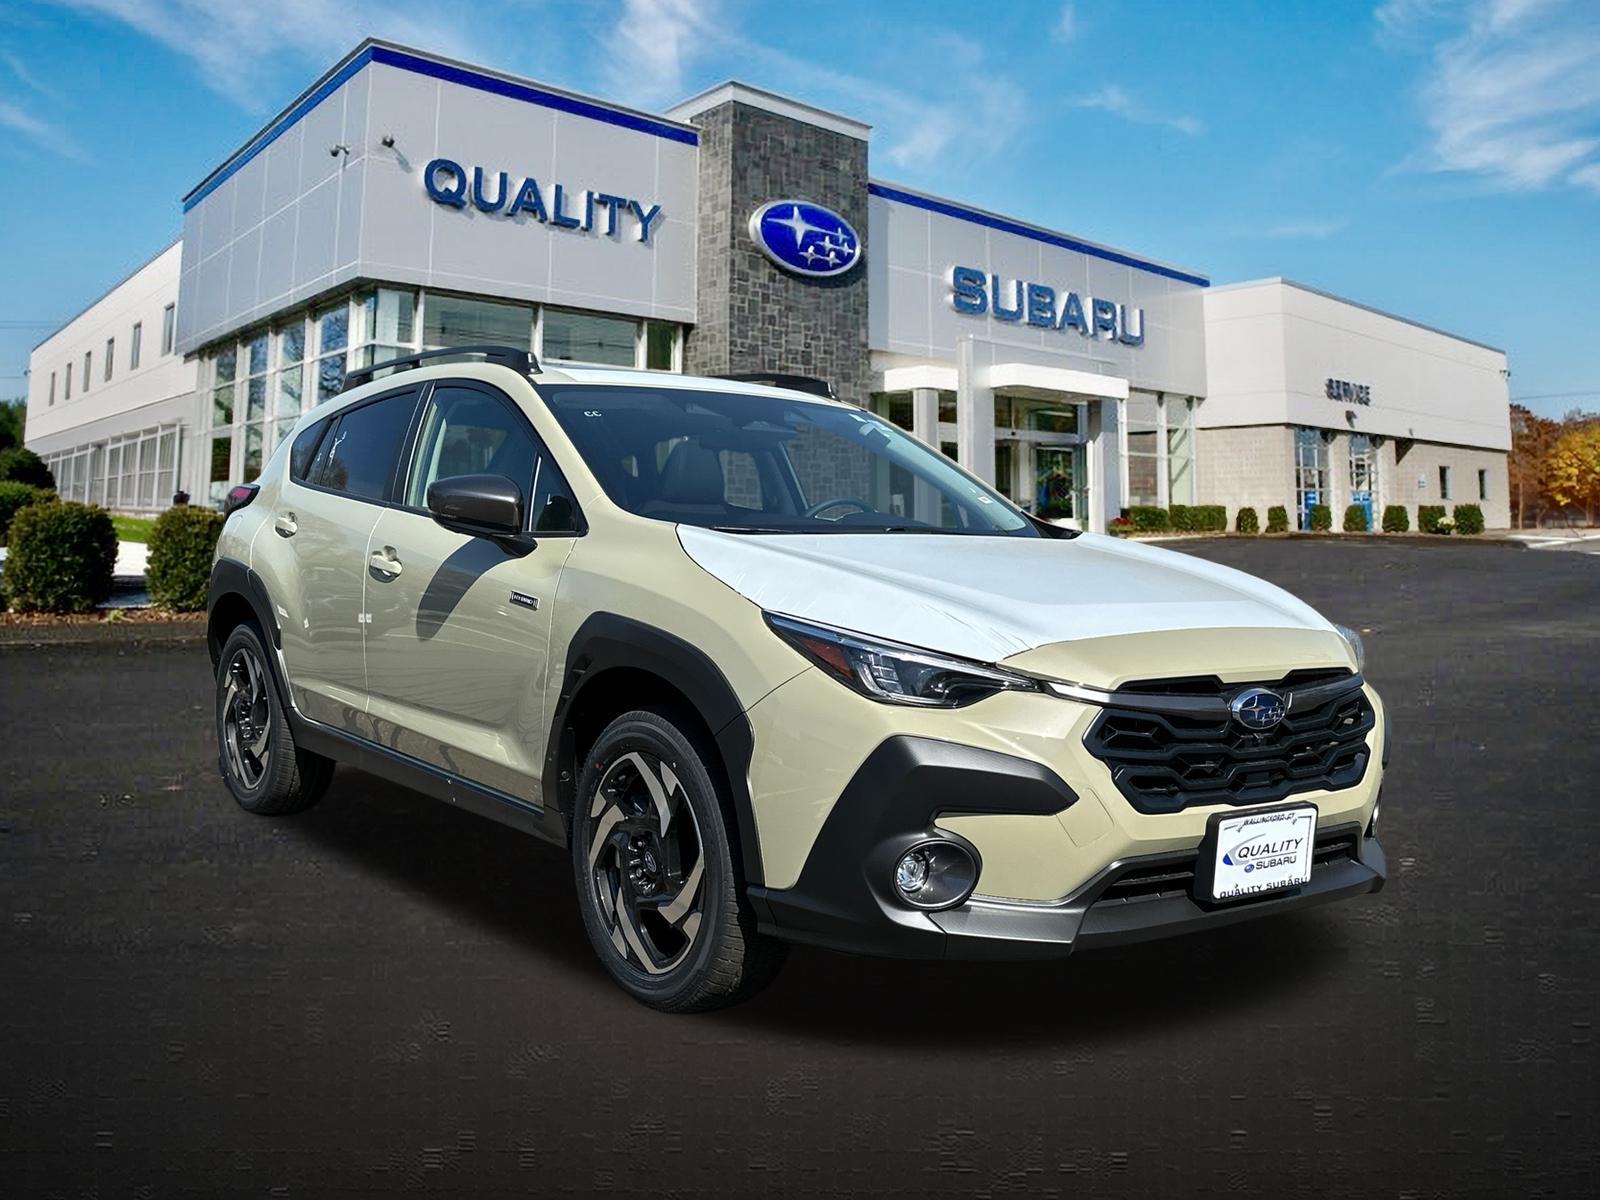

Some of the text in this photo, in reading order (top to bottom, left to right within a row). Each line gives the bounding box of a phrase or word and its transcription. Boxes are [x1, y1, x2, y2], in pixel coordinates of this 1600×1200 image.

[424, 158, 661, 243] QUALITY
[949, 265, 1145, 346] SUBARU
[1238, 838, 1303, 858] QUALITY
[1255, 855, 1297, 870] SUBARU
[1220, 876, 1308, 899] QUALITY SUBARU
